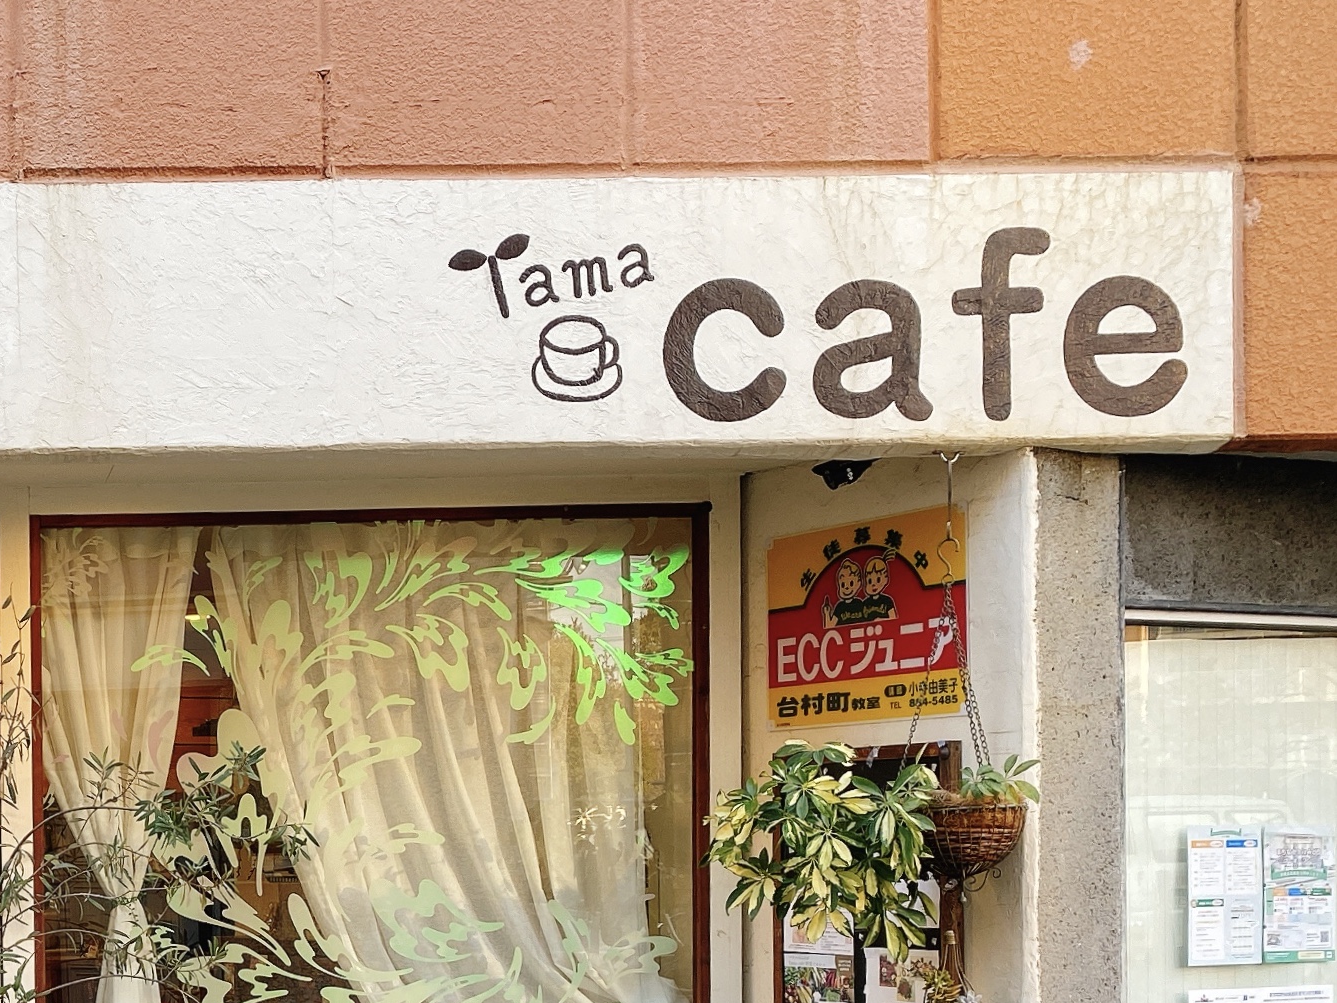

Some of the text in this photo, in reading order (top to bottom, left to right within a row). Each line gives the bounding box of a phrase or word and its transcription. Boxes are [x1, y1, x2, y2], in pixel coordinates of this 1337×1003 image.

[448, 226, 1189, 423] Tama cafe
[777, 692, 881, 717] 台村町教室
[890, 701, 902, 709] TEL
